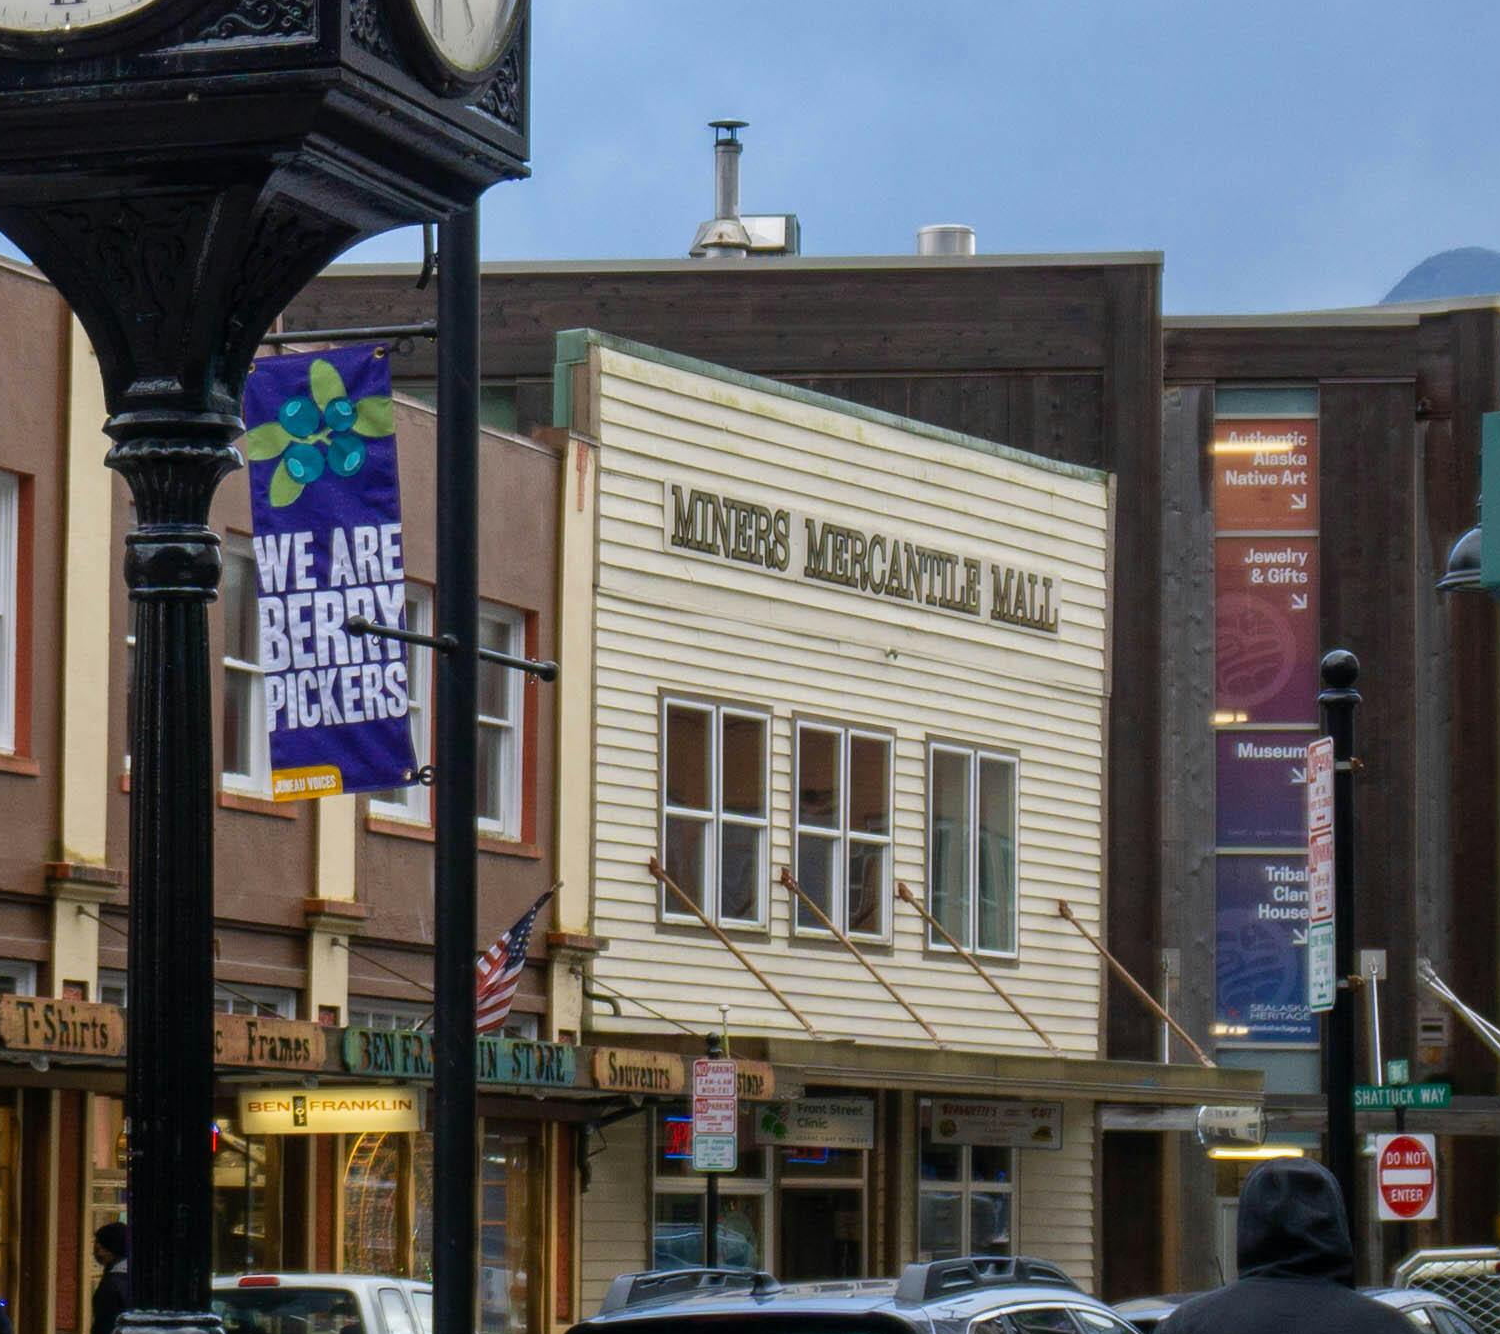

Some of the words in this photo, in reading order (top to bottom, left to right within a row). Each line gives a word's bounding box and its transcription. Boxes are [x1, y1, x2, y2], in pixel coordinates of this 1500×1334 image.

[1228, 431, 1307, 446] Authentic
[1253, 451, 1307, 467] Alaska
[1225, 470, 1278, 486] Native
[1281, 470, 1308, 486] Art
[253, 531, 314, 594] WE
[330, 523, 403, 587] ARE
[671, 485, 790, 571] MINERS
[804, 518, 982, 616] MERCANTILE
[990, 564, 1058, 633] MALL
[1245, 548, 1308, 567] Jewelry
[1251, 569, 1264, 584] &
[1267, 569, 1308, 584] Gifts
[257, 584, 406, 672] BERRY
[264, 661, 408, 732] PICKERS
[1238, 742, 1307, 759] Museum
[307, 775, 337, 791] VOICES
[1265, 866, 1310, 882] Tribal
[1273, 887, 1310, 902] Clan
[1258, 904, 1311, 920] House
[1250, 1011, 1312, 1021] HERITAGE
[246, 1020, 311, 1062] Frames
[359, 1031, 396, 1073] BEN
[512, 1043, 565, 1083] STORE
[609, 1051, 670, 1090] Souvenirs
[737, 1070, 764, 1094] stone
[1354, 1088, 1414, 1106] SHATTUCK
[1421, 1088, 1445, 1104] WAY
[248, 1101, 291, 1113] BEN
[310, 1099, 412, 1112] FRANKLIN
[798, 1103, 826, 1116] Front
[831, 1104, 863, 1116] Street
[797, 1118, 828, 1130] Clinic
[1386, 1153, 1400, 1165] DO
[1405, 1151, 1427, 1164] NOT
[1391, 1189, 1424, 1202] ENTER
